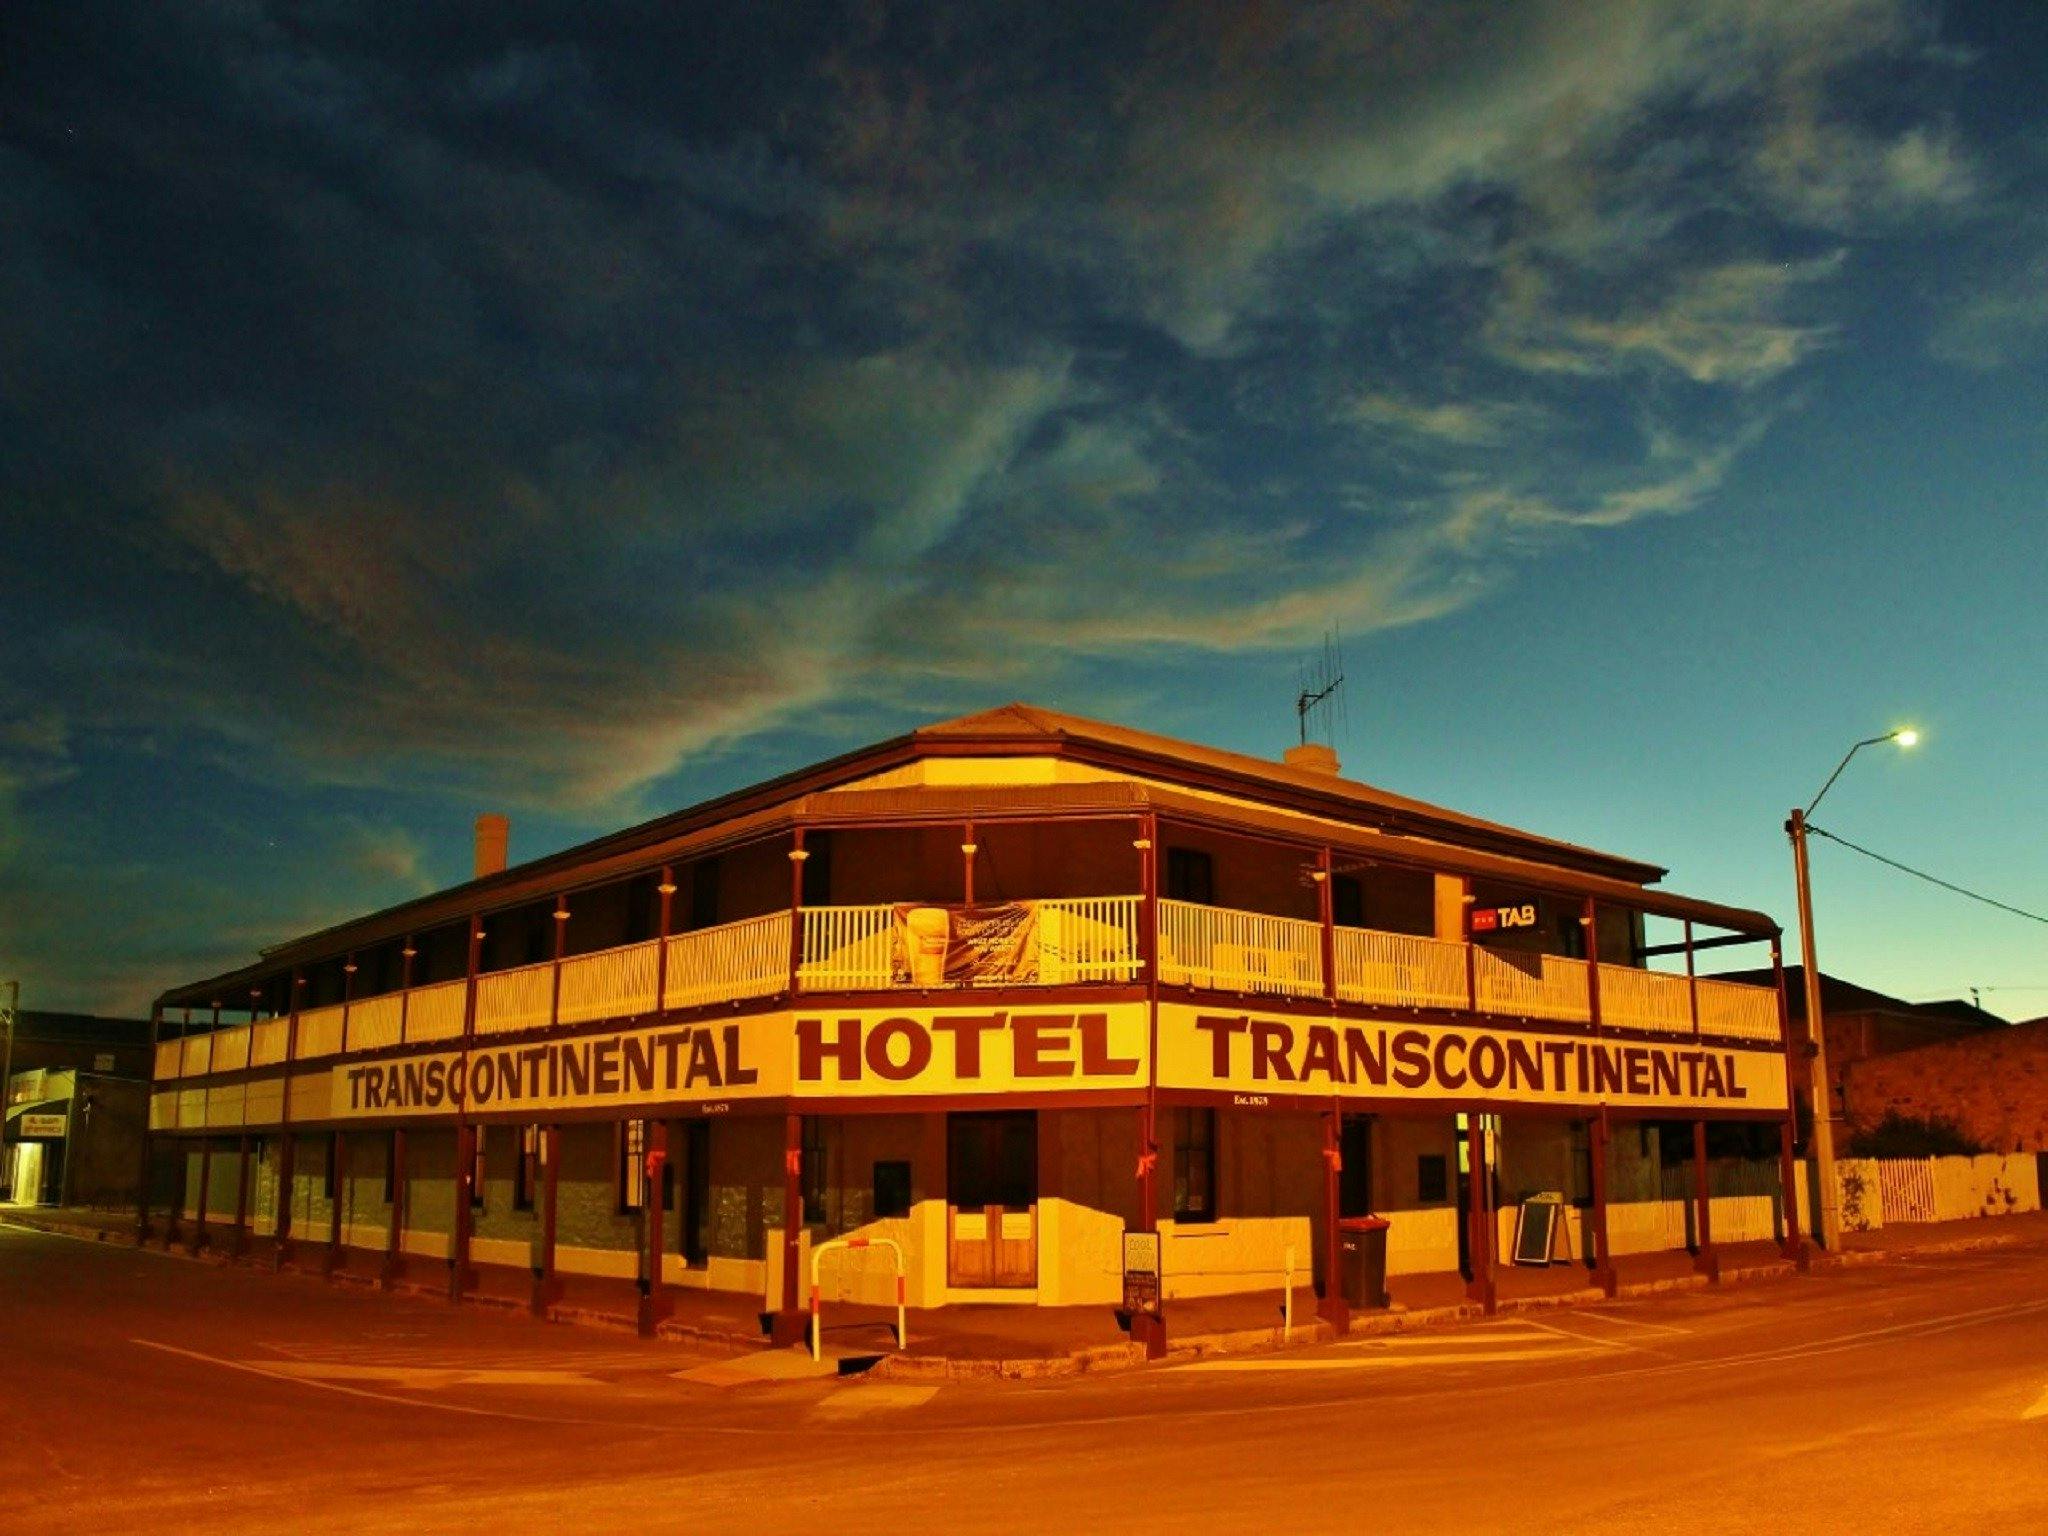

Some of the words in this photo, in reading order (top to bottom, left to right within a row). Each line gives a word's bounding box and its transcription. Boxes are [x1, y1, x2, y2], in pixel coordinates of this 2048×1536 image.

[1498, 905, 1535, 928] TAB
[347, 1024, 758, 1109] TRANSCONTINENTAL
[795, 1011, 1140, 1081] HOTEL
[1196, 1015, 1747, 1099] TRANSCONTINENTAL
